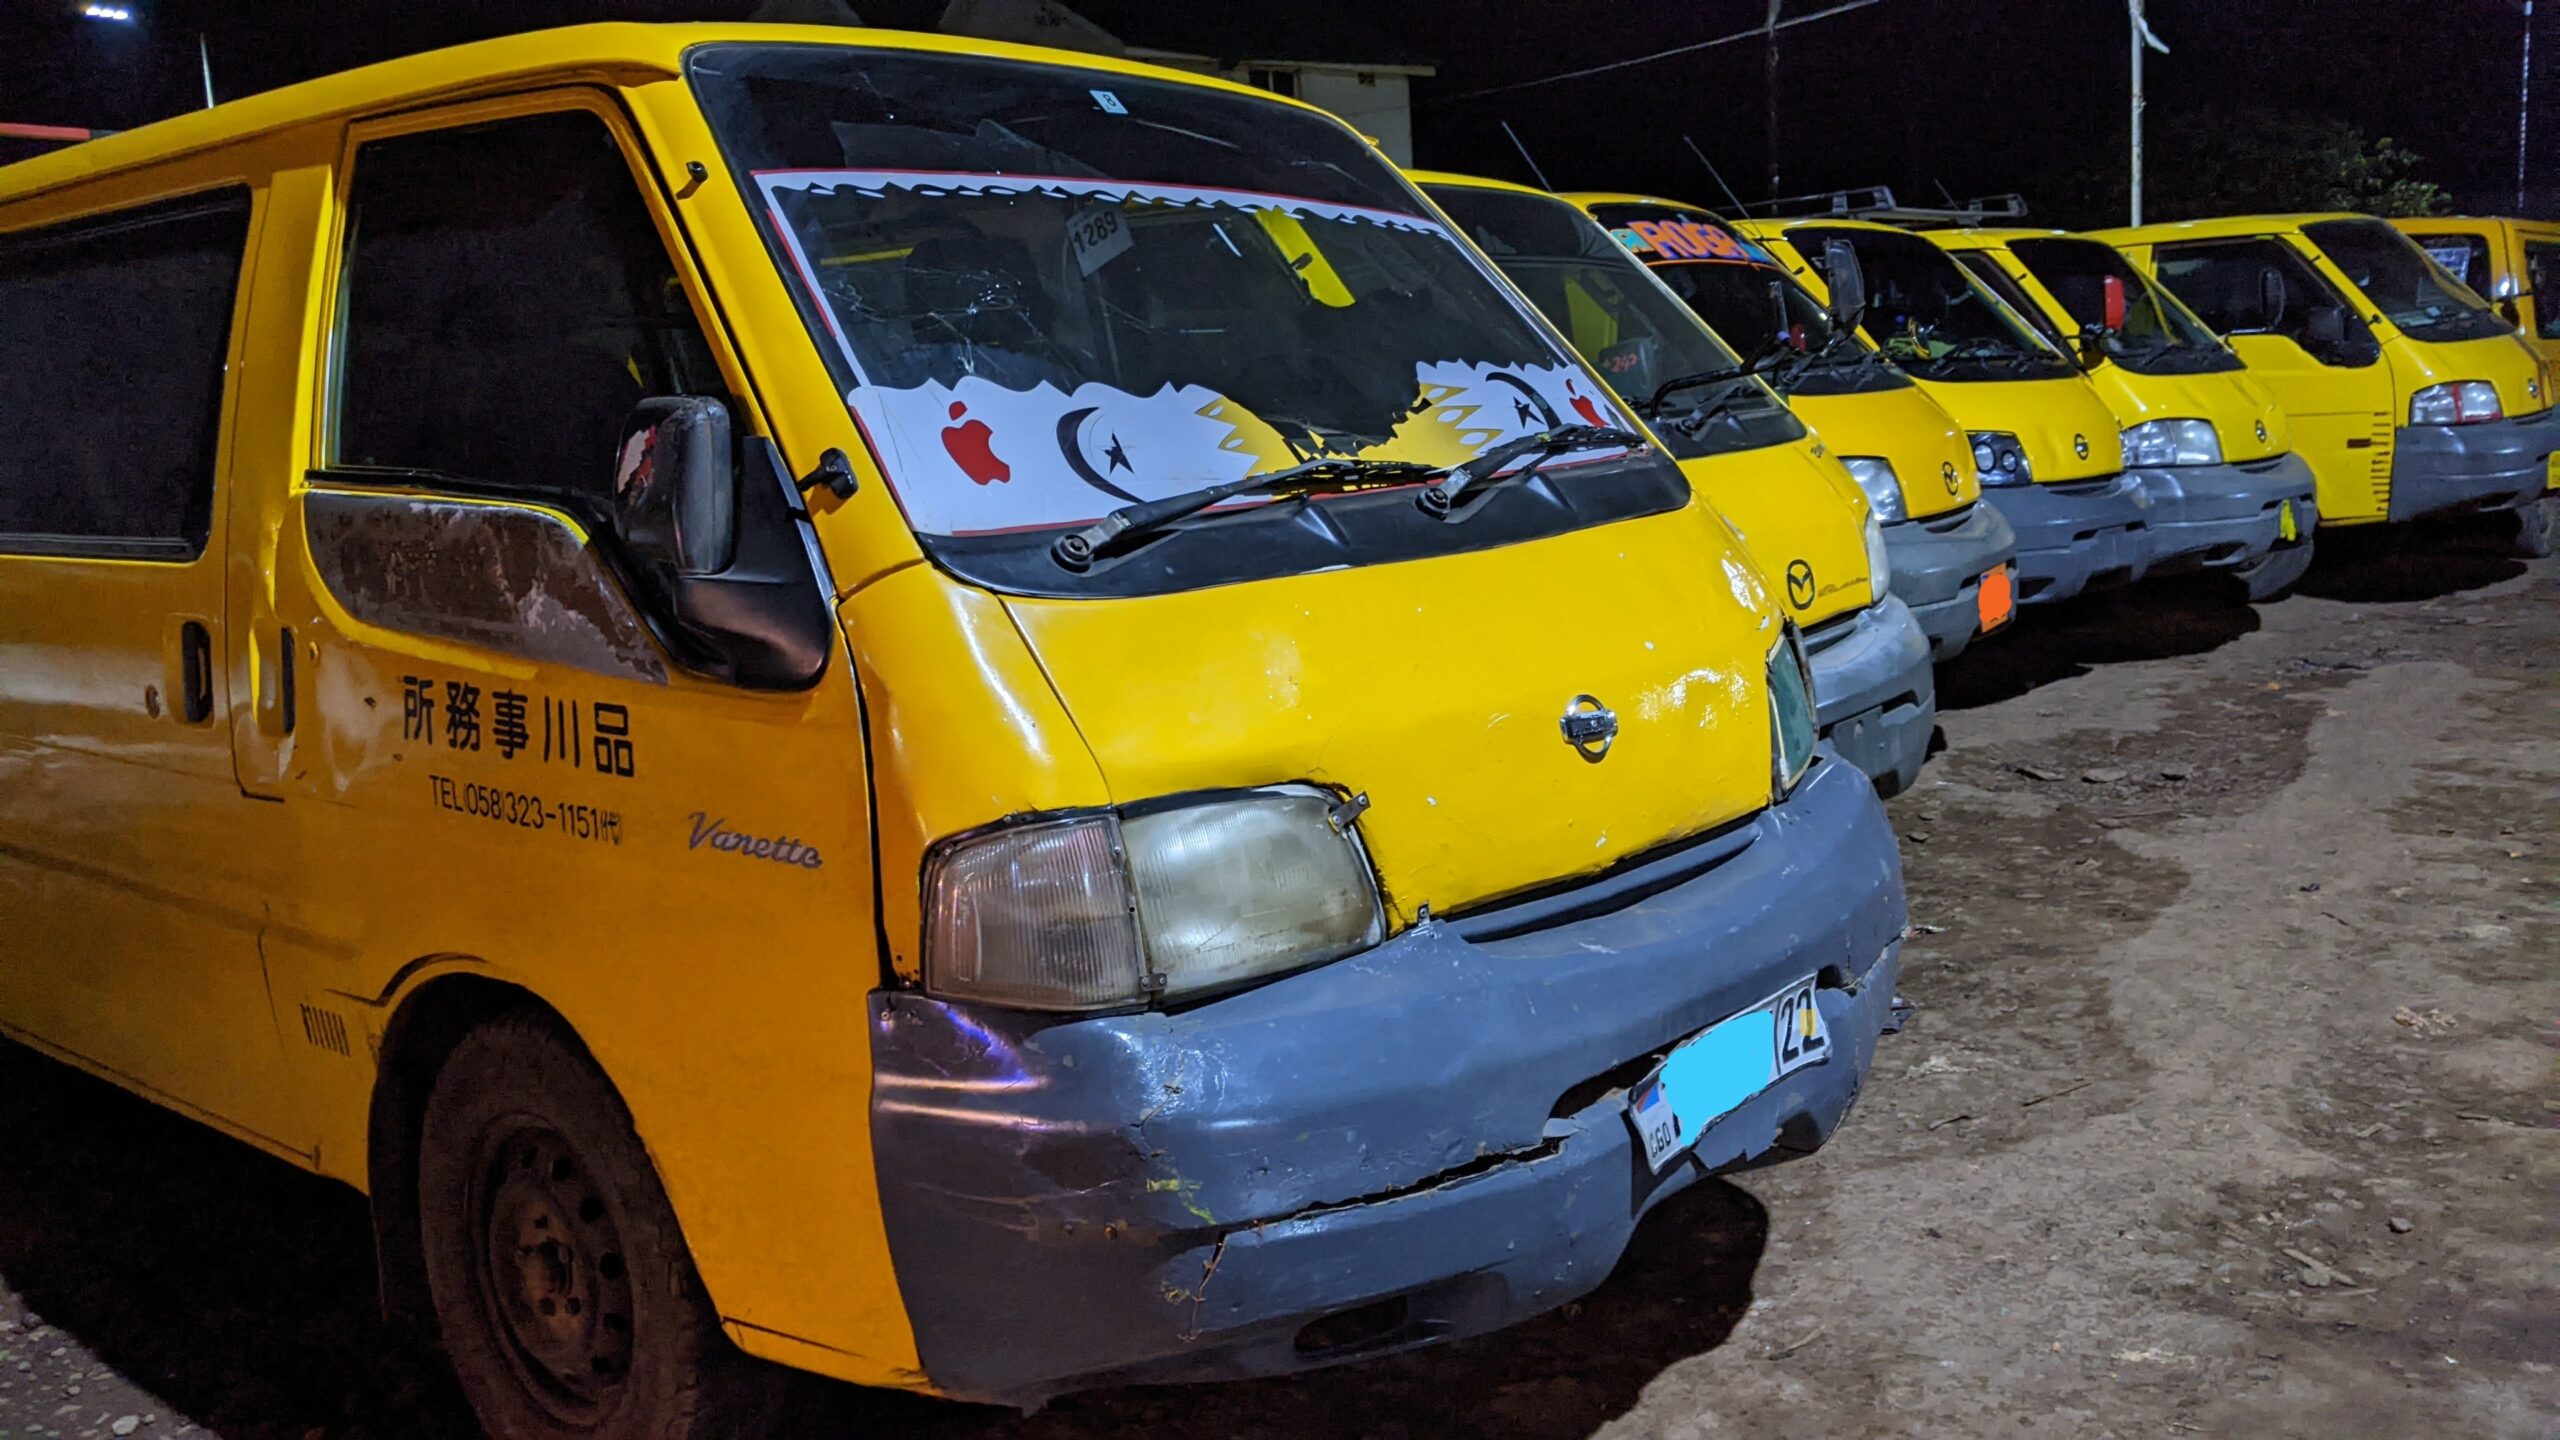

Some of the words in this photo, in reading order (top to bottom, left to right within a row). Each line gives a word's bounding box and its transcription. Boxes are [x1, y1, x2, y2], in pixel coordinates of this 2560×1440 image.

[1073, 211, 1118, 253] 1289
[688, 811, 824, 869] Vanette
[1780, 988, 1826, 1065] 22
